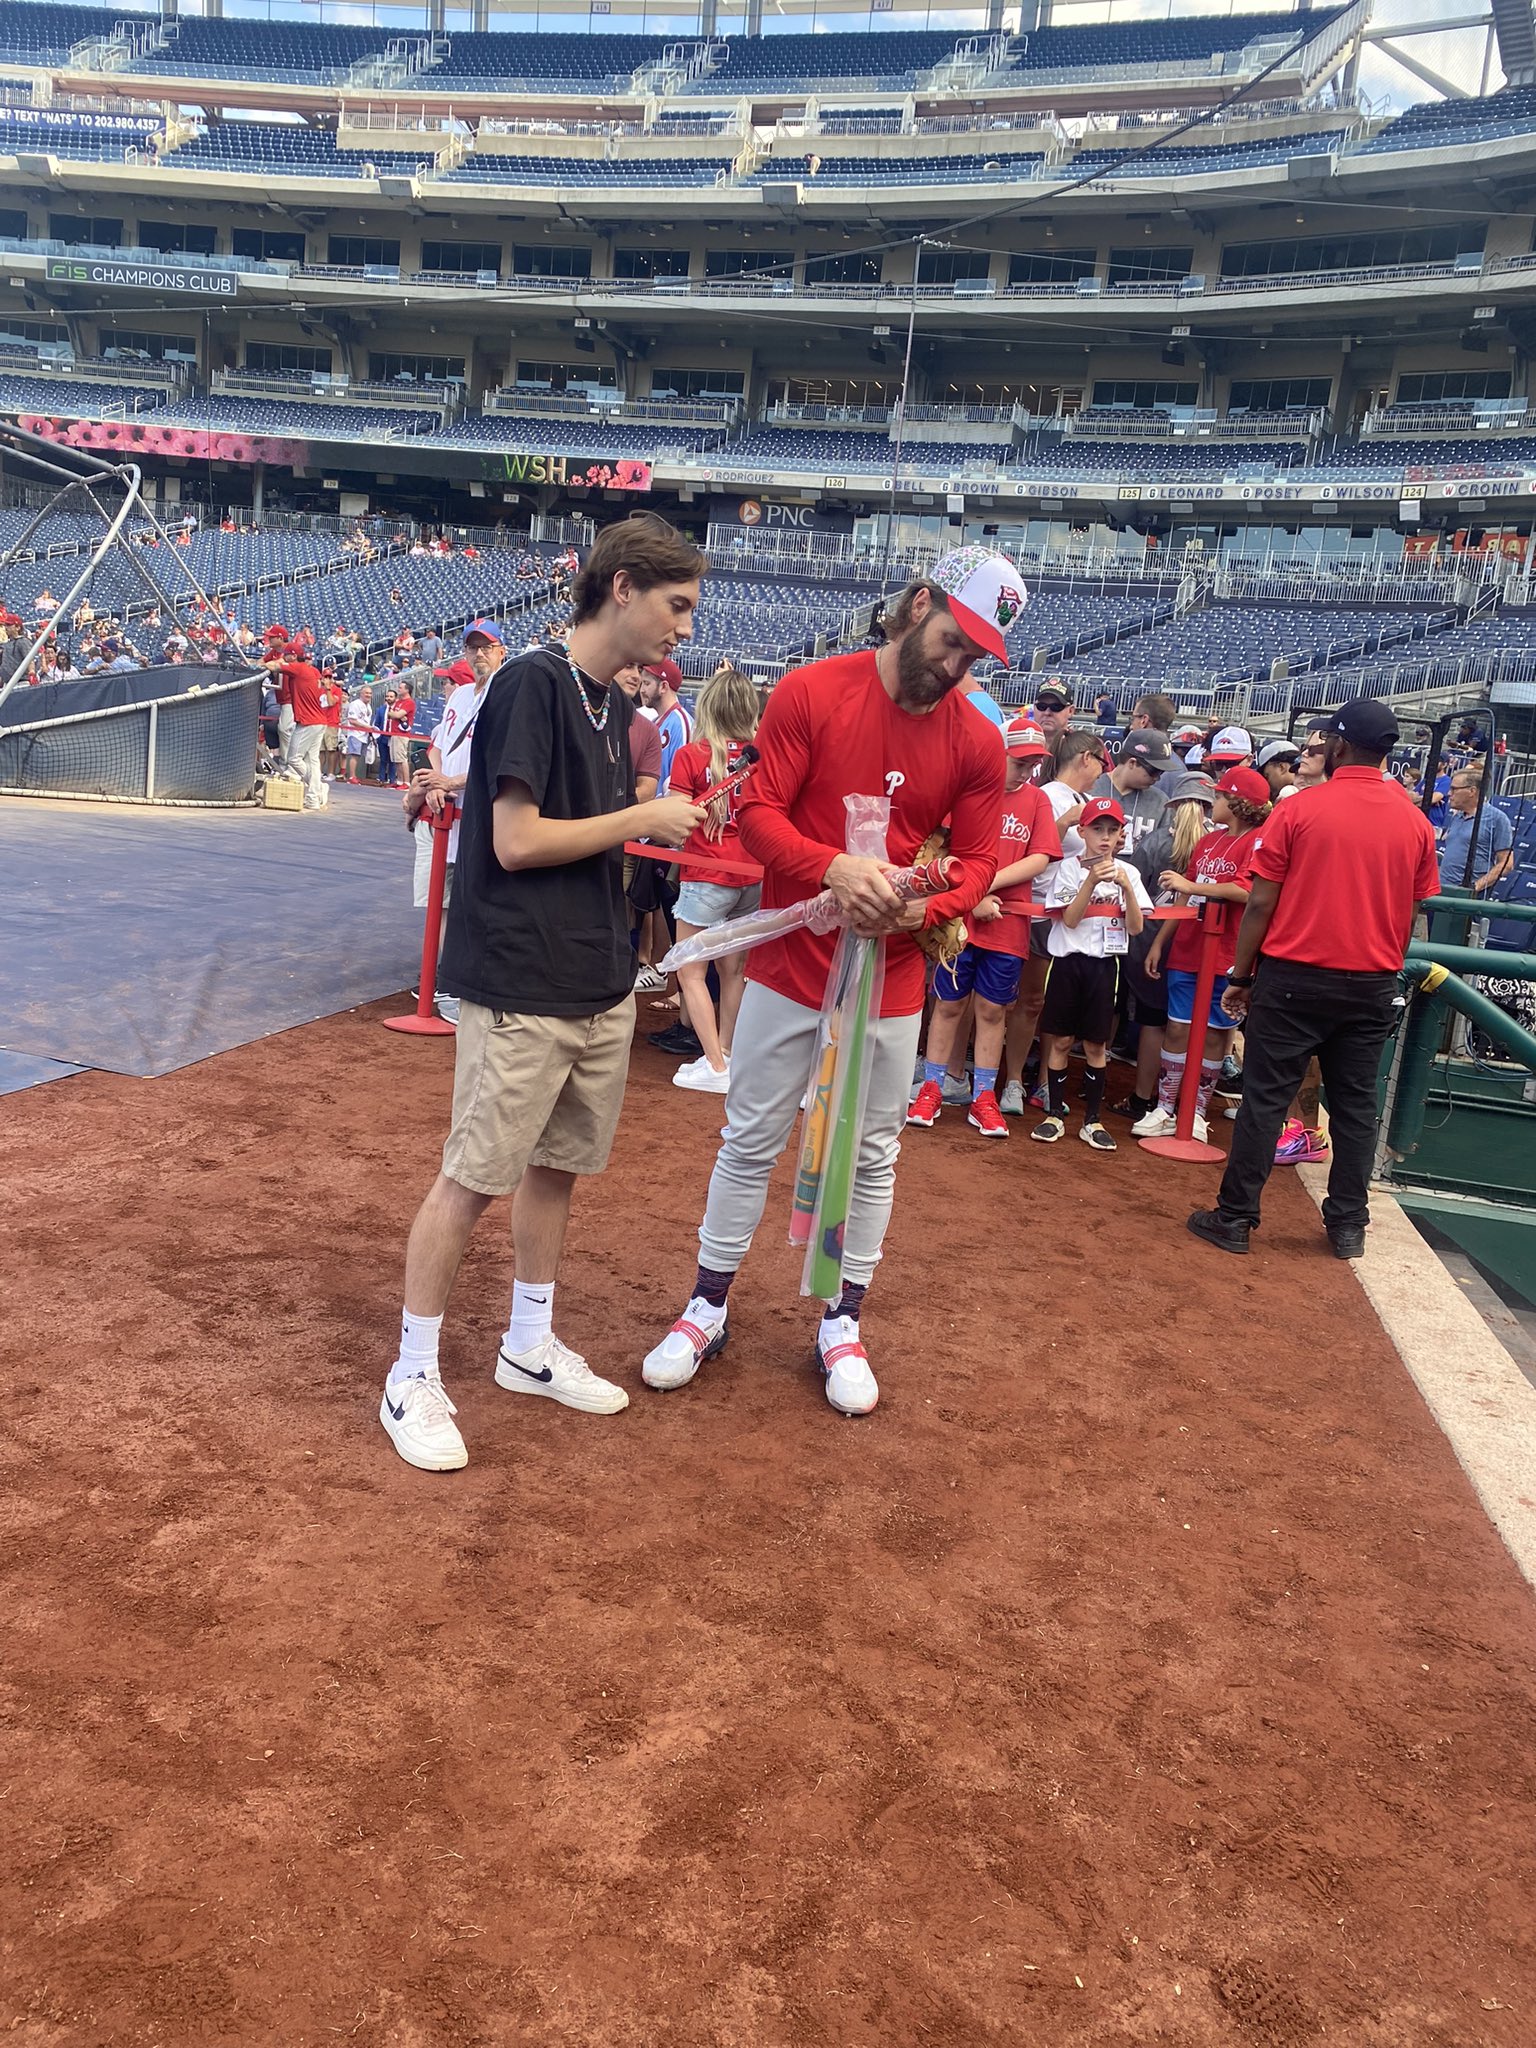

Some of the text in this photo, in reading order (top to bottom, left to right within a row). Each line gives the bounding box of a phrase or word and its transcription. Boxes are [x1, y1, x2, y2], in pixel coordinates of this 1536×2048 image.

[14, 109, 40, 123] TEXT
[79, 114, 93, 126] TO
[94, 115, 160, 131] 202.980.4357
[92, 266, 185, 288] CHAMPIONS
[189, 275, 231, 292] CLUB
[504, 455, 567, 483] WSH
[828, 479, 843, 487] 126
[895, 481, 925, 492] BELL
[953, 482, 1000, 494] BROWN
[1458, 482, 1520, 496] CRONIN
[1029, 485, 1079, 497] GIBSON
[1121, 489, 1137, 498] 125
[1160, 487, 1224, 498] LEONARD
[1254, 487, 1303, 498] POSEY
[1336, 487, 1395, 499] WILSON
[1404, 487, 1422, 497] 124
[765, 504, 816, 527] PNC
[885, 770, 905, 796] P
